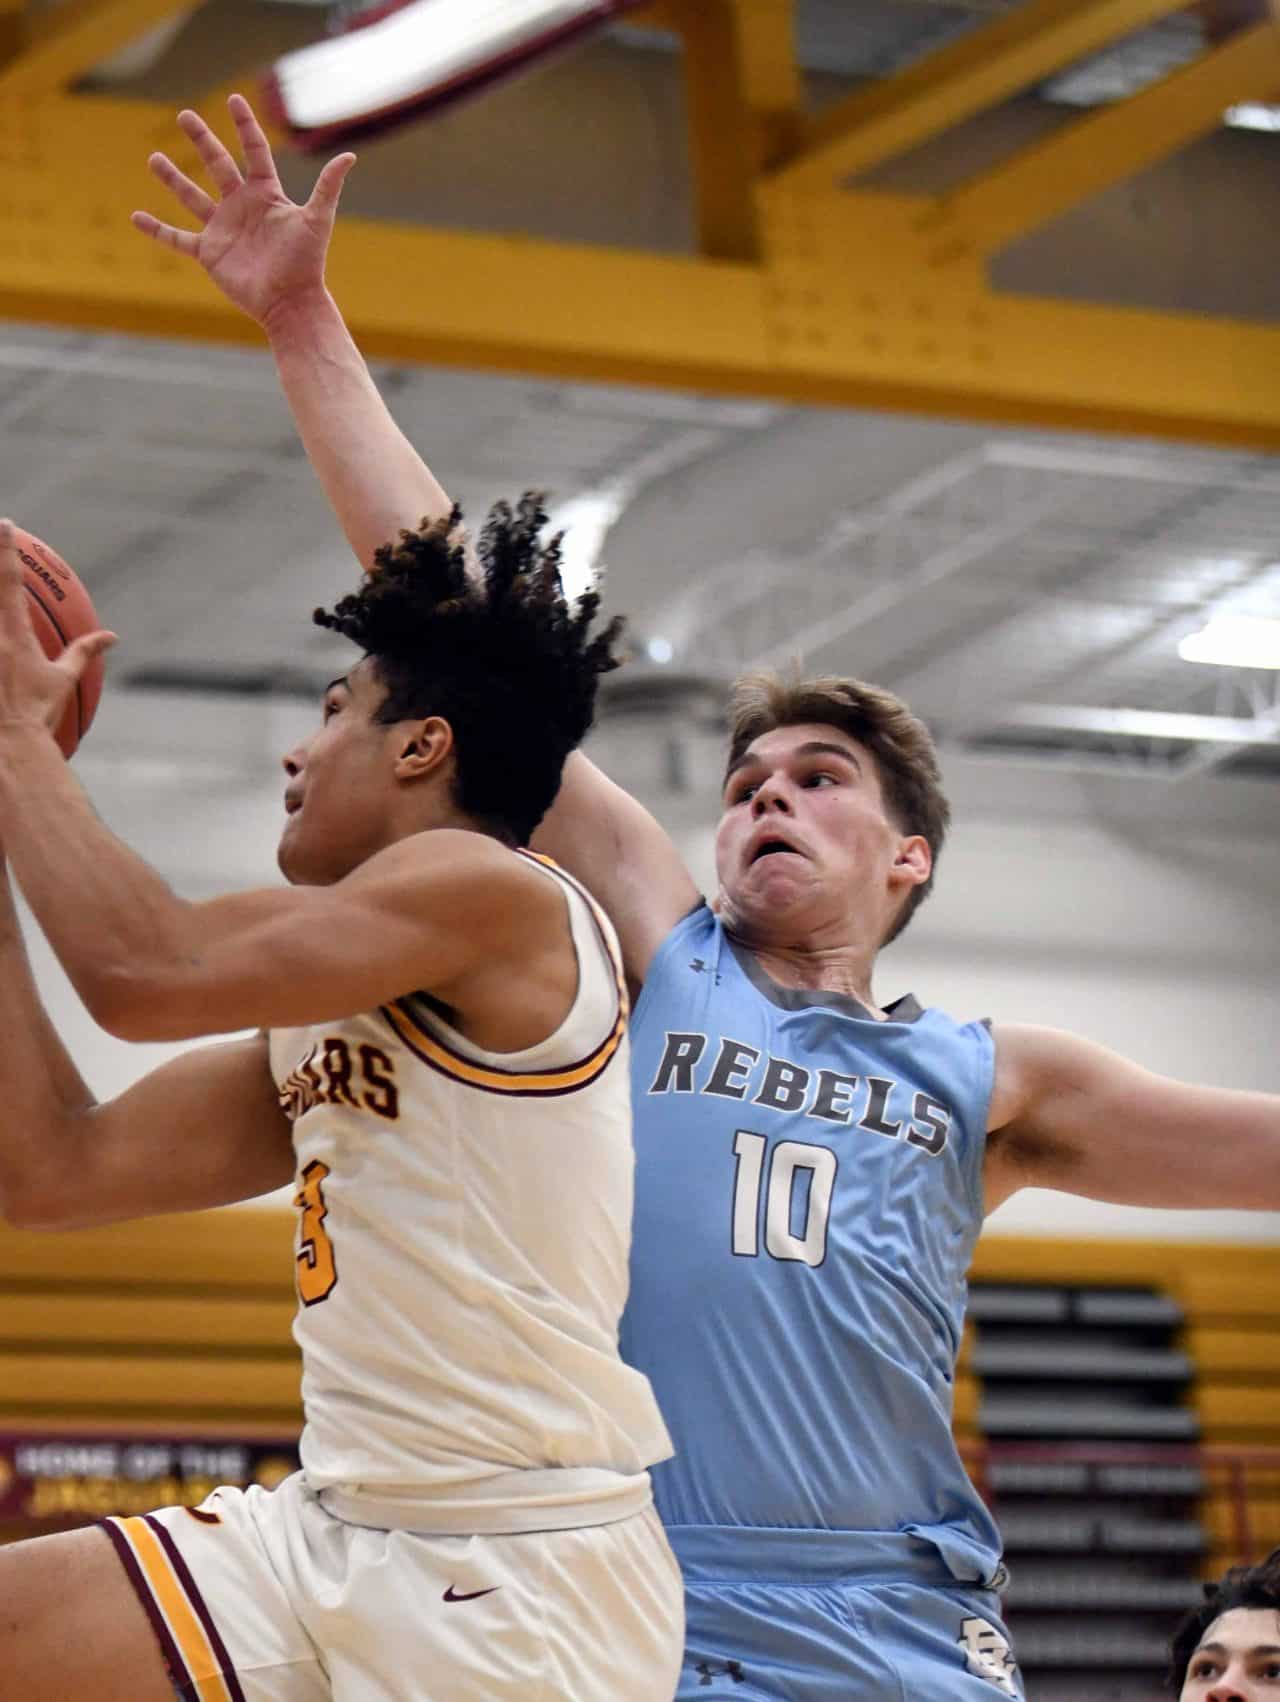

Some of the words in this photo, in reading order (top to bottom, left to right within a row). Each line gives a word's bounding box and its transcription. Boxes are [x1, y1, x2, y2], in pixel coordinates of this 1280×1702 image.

[17, 548, 66, 602] GUARS
[647, 1031, 952, 1156] REBELS
[731, 1129, 838, 1269] 10
[16, 1445, 117, 1478] HOME
[123, 1446, 172, 1479] OF
[180, 1447, 247, 1479] THE
